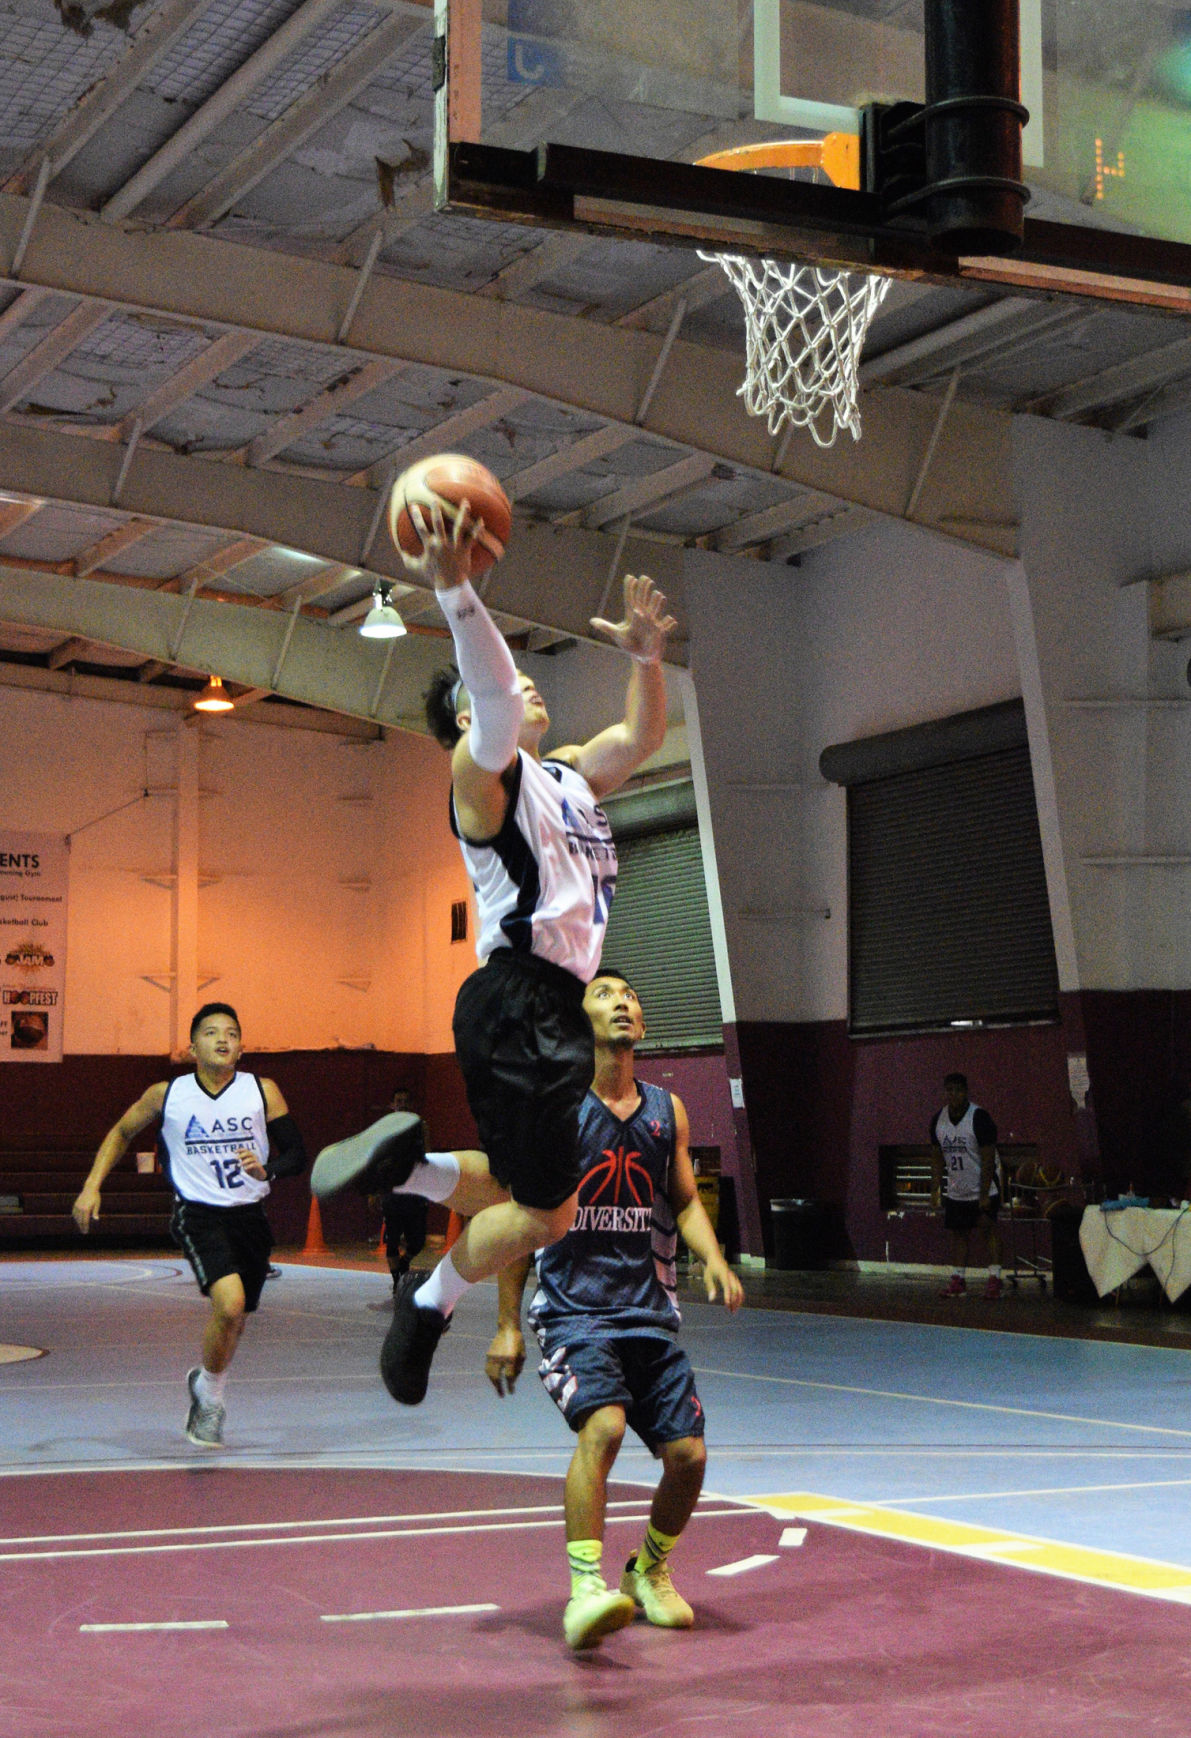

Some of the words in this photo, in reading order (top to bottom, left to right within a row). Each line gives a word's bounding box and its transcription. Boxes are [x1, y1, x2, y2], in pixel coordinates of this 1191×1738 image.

[0, 853, 40, 868] ENTS
[20, 893, 62, 903] Tournament
[31, 917, 49, 927] Club
[211, 1116, 253, 1133] ASC
[649, 1119, 661, 1137] 2
[186, 1142, 257, 1155] BASKETBALL
[951, 1155, 964, 1170] 21
[210, 1158, 245, 1189] 12
